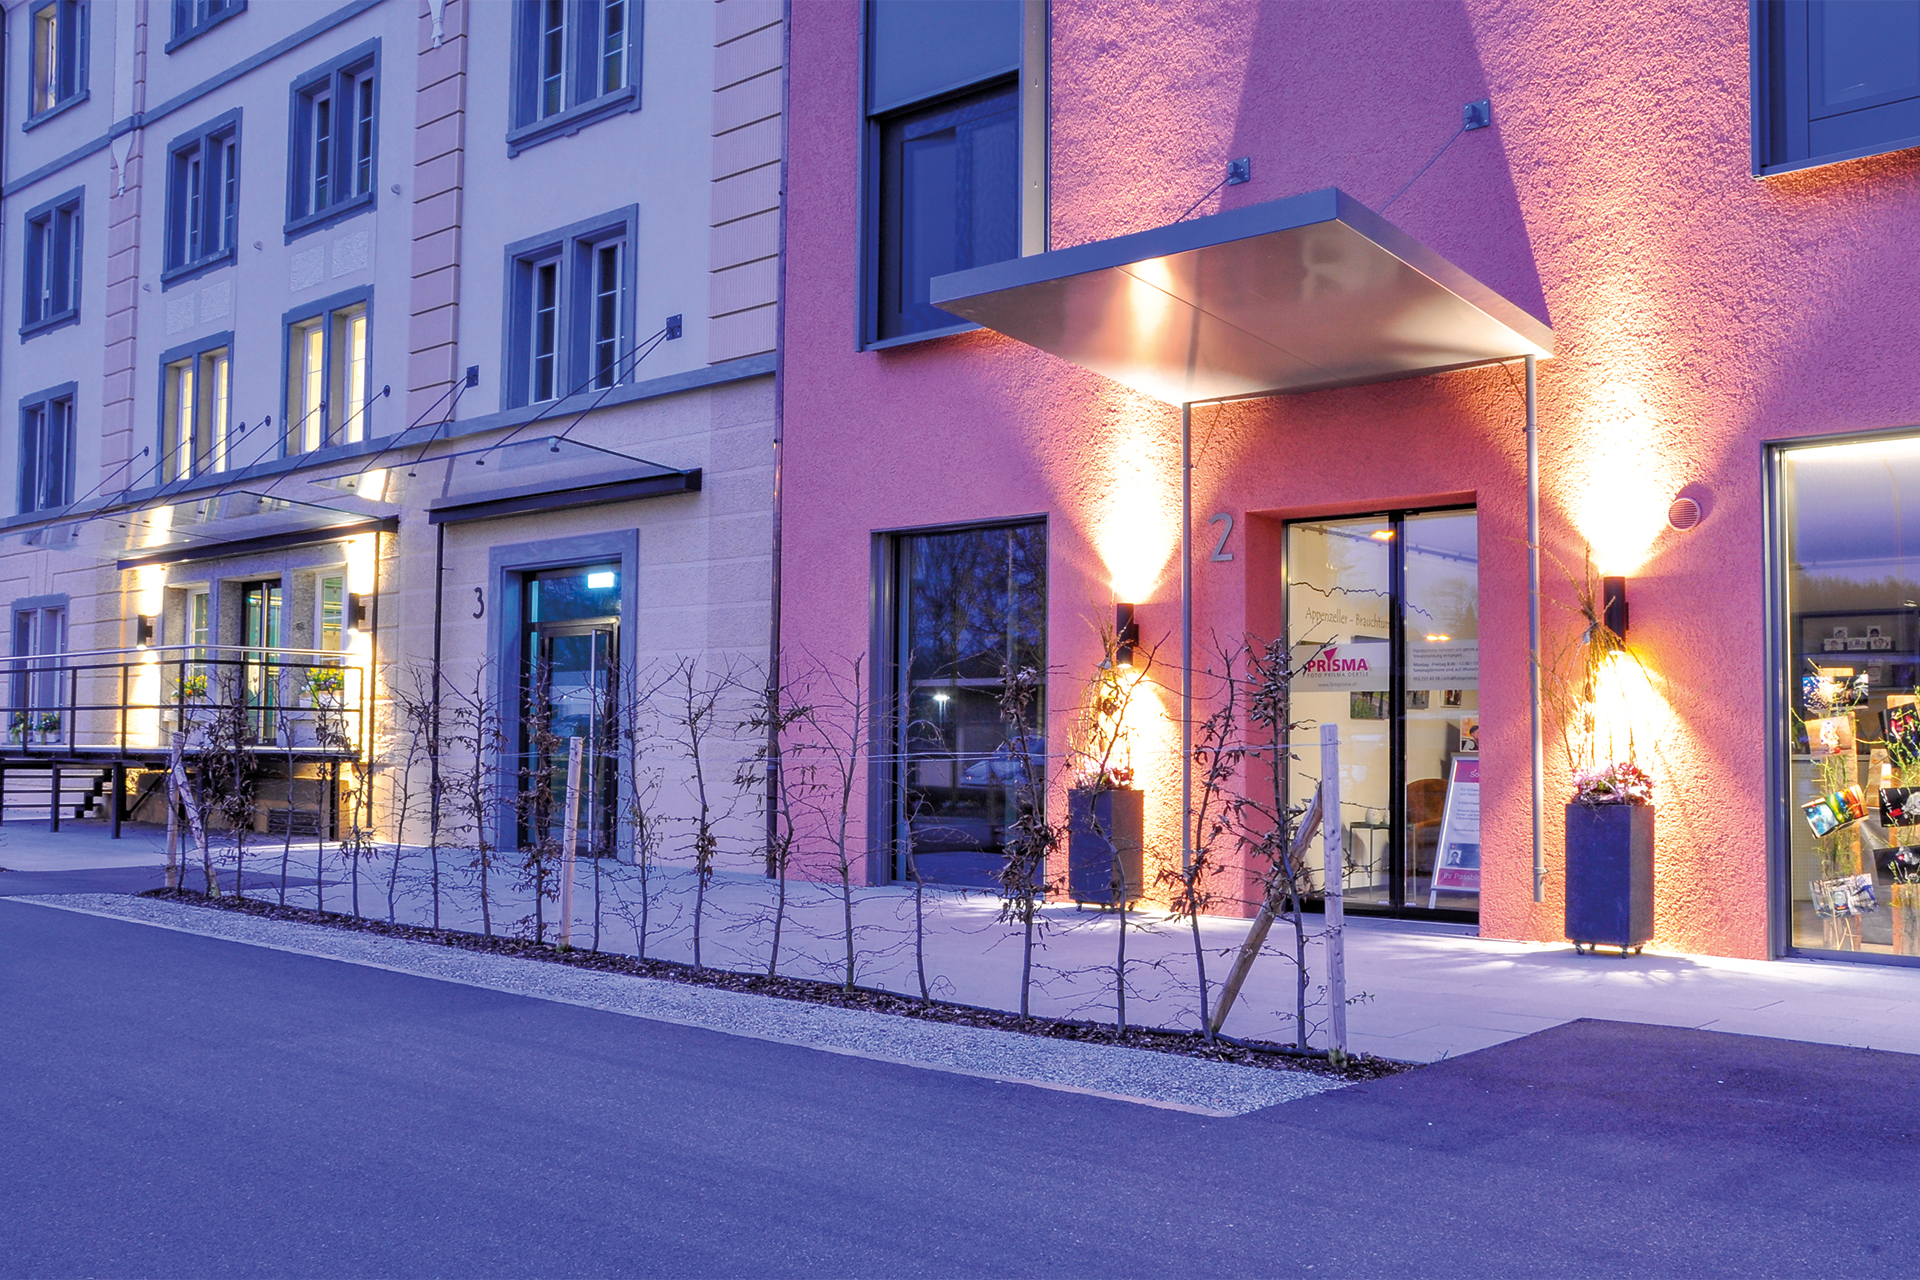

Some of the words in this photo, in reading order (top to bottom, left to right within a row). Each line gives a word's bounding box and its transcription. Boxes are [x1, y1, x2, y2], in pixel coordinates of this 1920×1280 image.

[1208, 512, 1234, 562] 2
[472, 586, 485, 619] 3
[1305, 607, 1348, 624] Appenzeller
[1307, 656, 1368, 672] PRISMA
